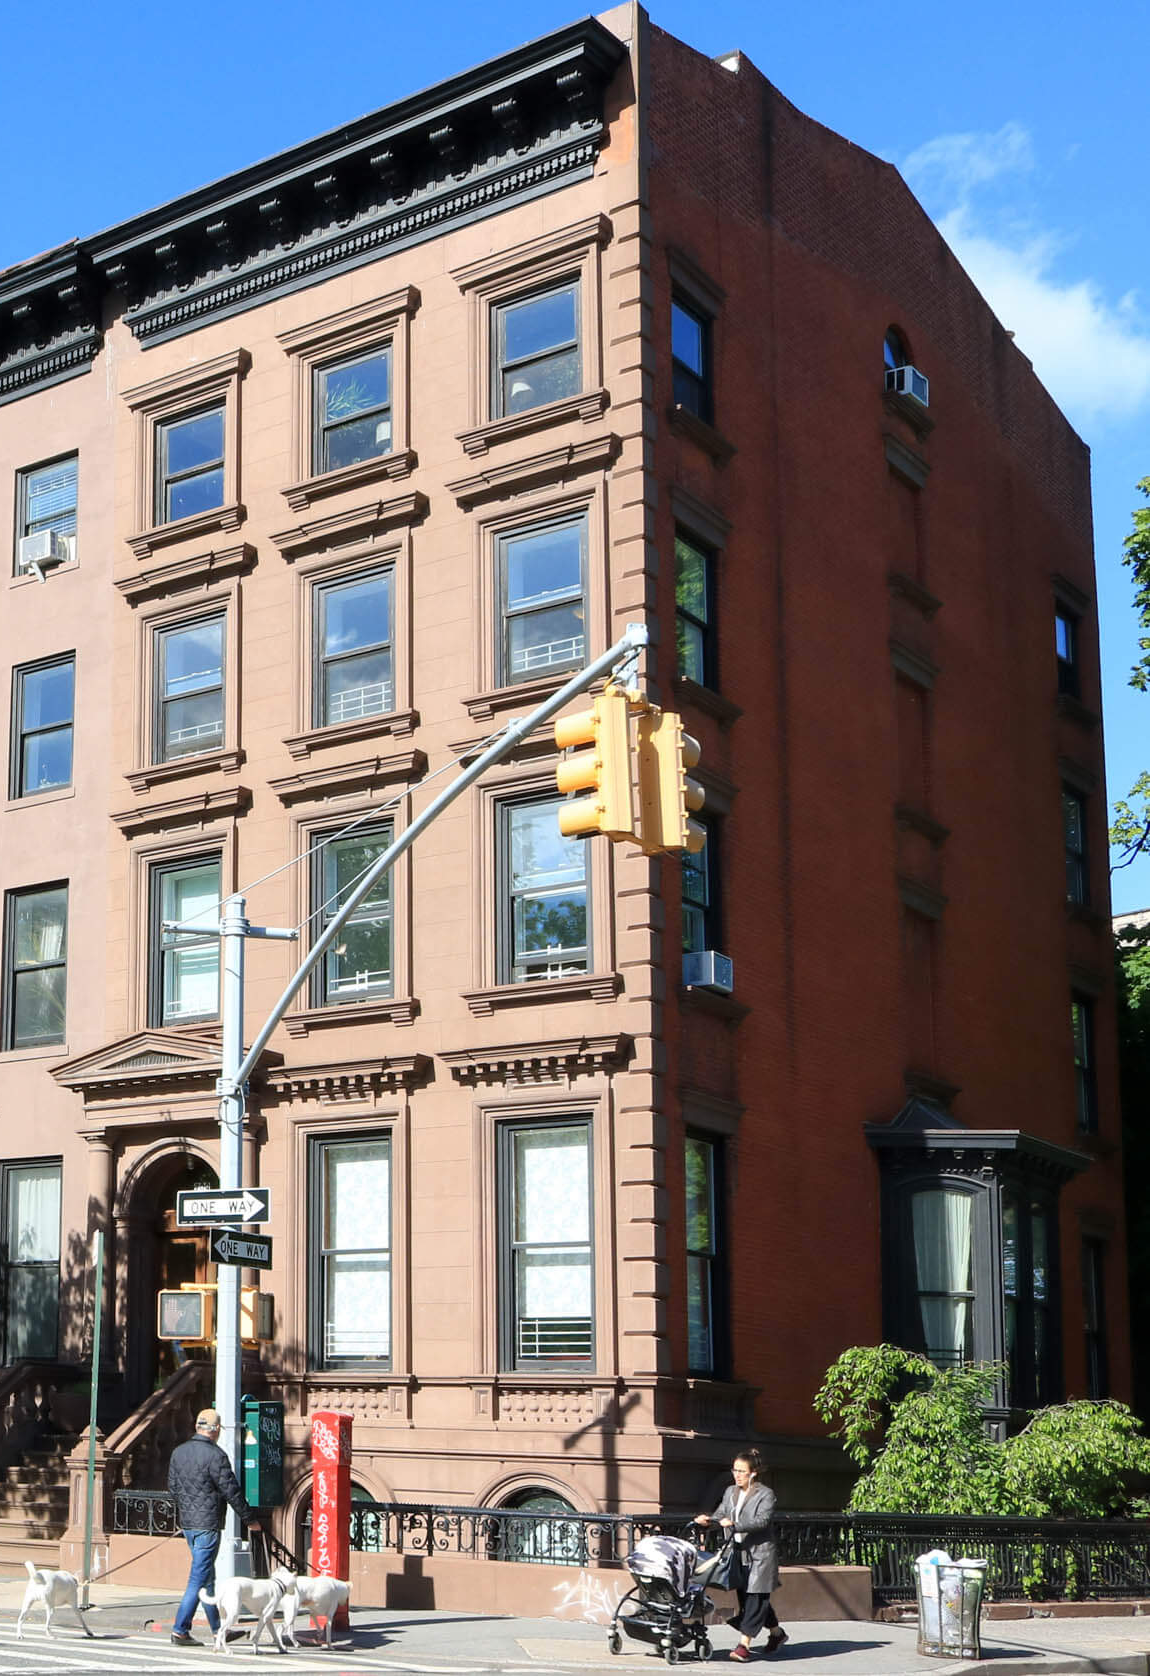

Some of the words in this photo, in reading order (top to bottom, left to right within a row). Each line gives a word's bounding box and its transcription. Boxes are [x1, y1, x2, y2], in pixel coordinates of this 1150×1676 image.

[191, 1201, 216, 1214] ONE
[229, 1200, 255, 1213] WAY
[220, 1240, 239, 1255] ONE
[246, 1243, 266, 1259] WAY
